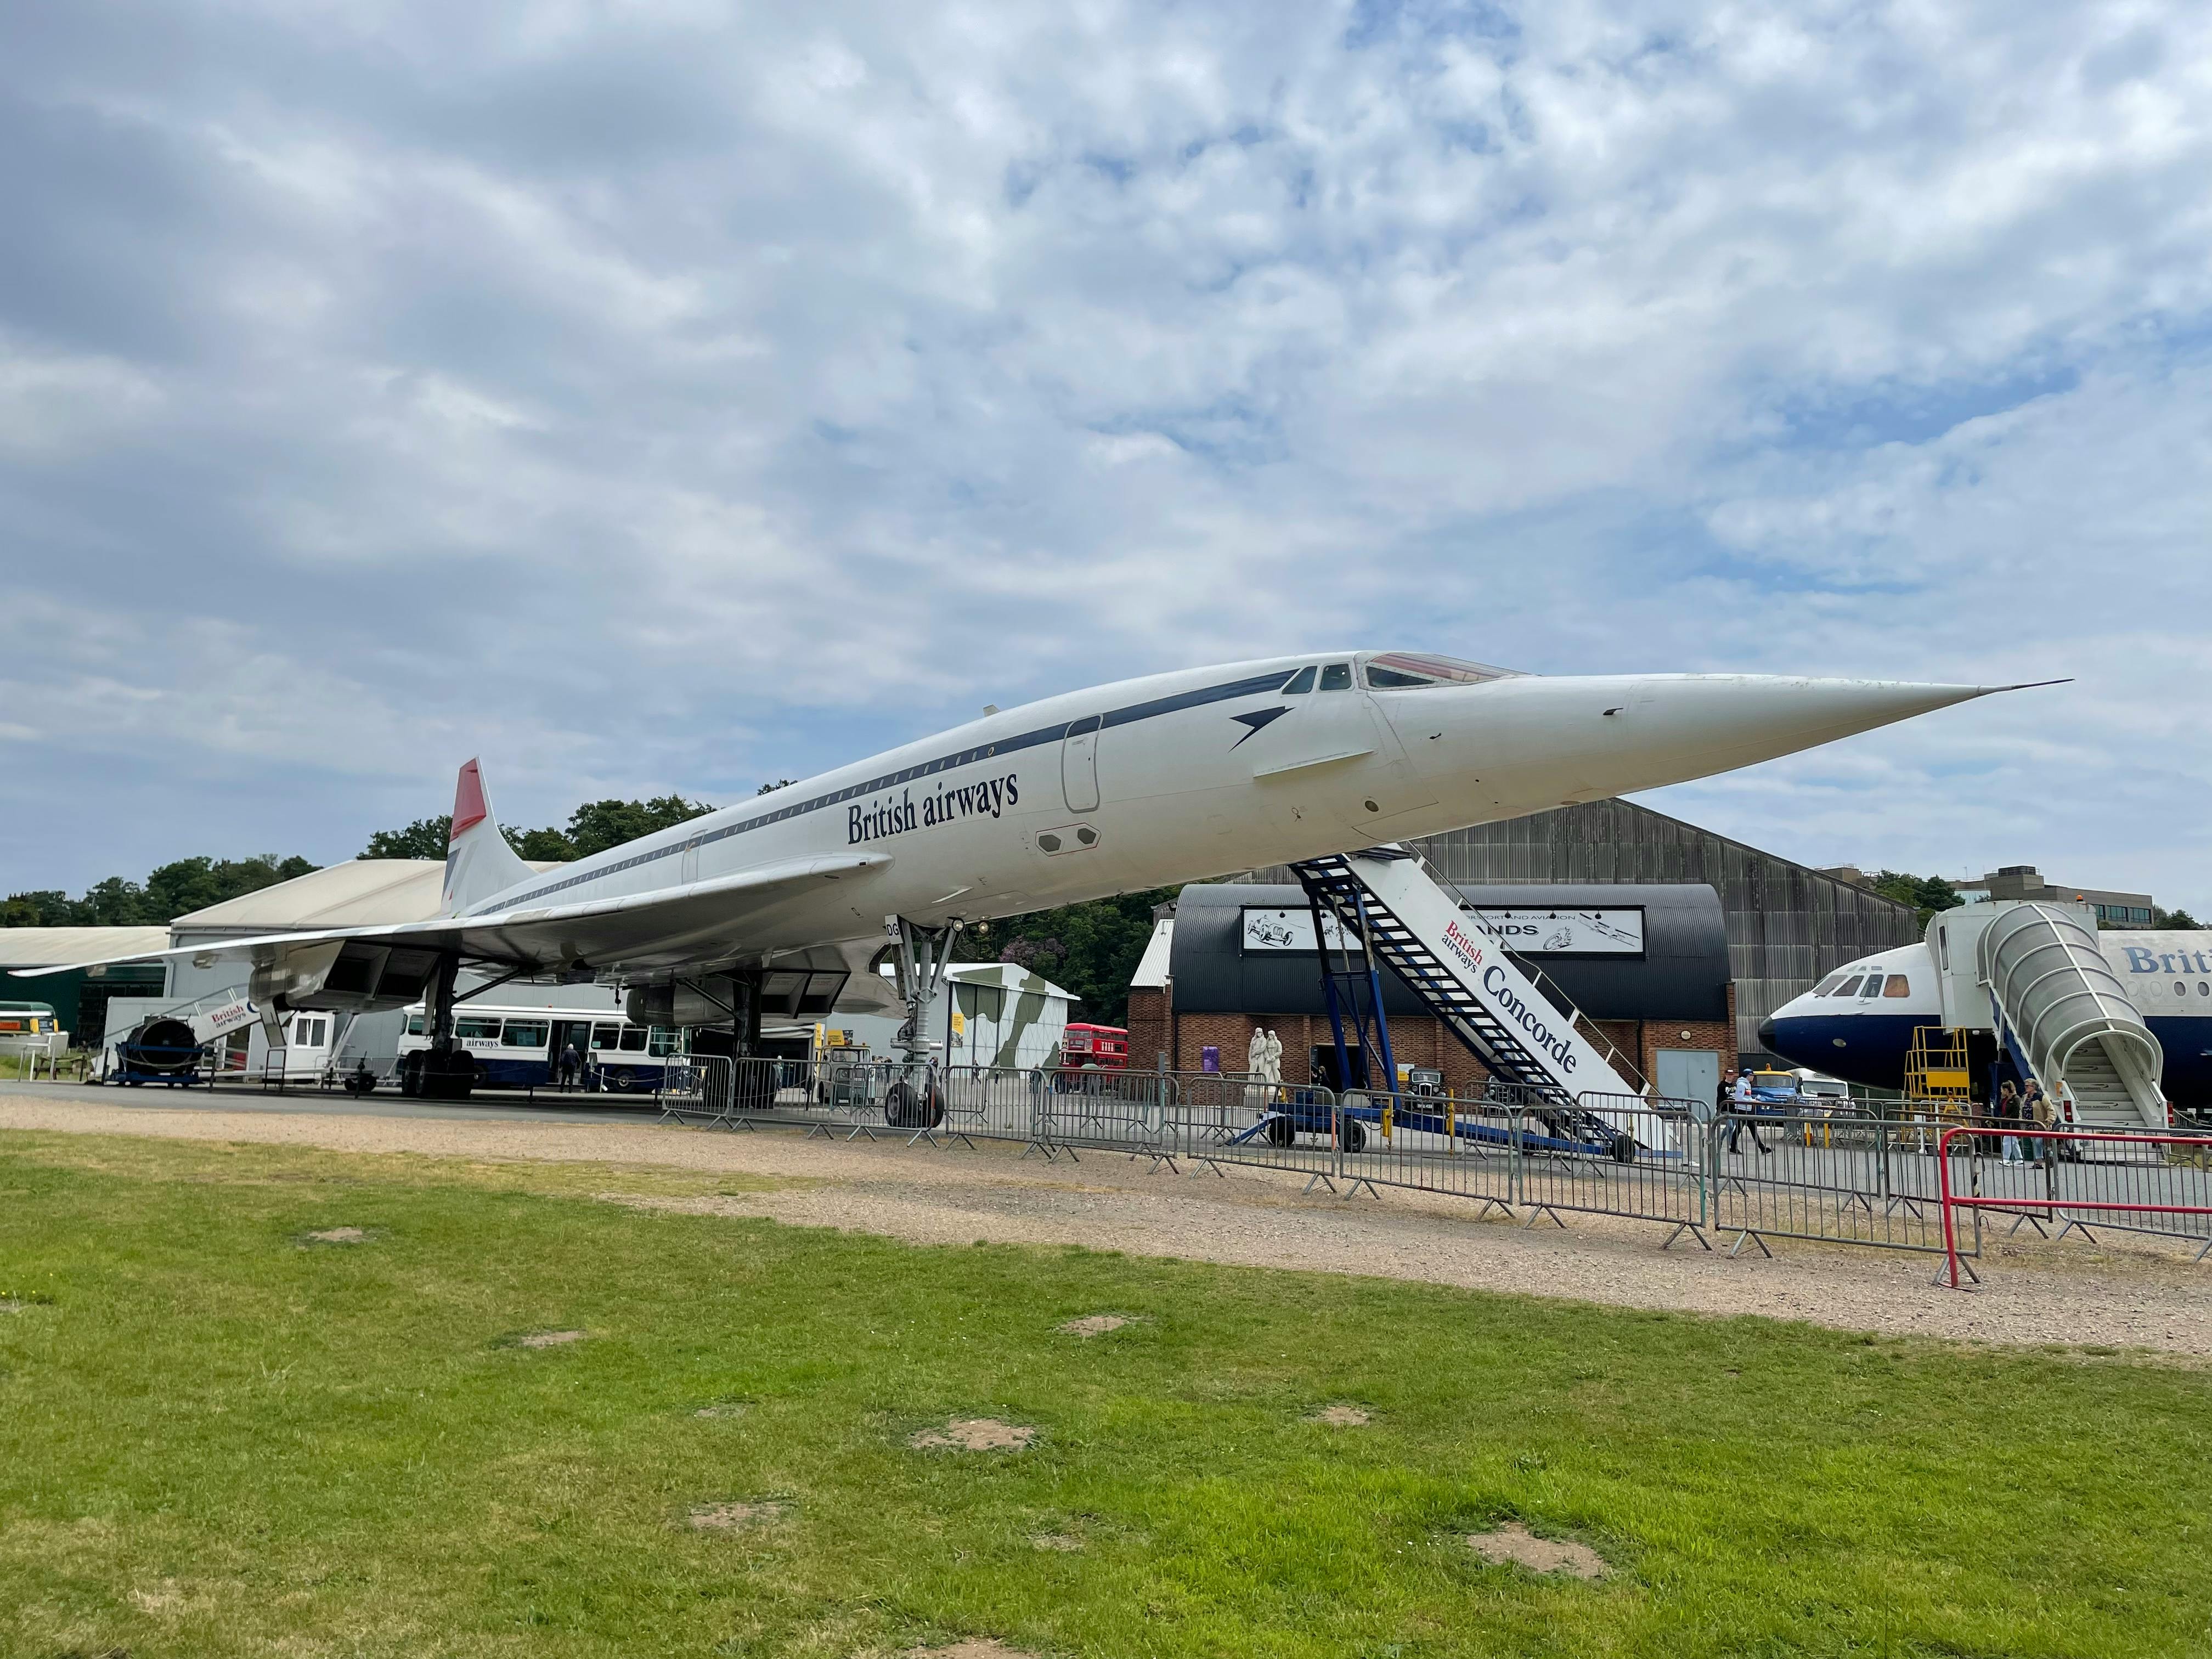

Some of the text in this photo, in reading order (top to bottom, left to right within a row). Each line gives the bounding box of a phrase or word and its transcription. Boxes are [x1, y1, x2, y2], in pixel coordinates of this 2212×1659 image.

[848, 774, 1019, 844] British airways
[887, 923, 900, 936] DG
[1445, 920, 1483, 966] British
[1442, 934, 1477, 973] airways
[2121, 947, 2212, 974] Brit
[212, 1005, 244, 1022] British
[216, 1013, 246, 1028] airways
[1483, 966, 1576, 1074] Concorde
[466, 1038, 499, 1048] airways
